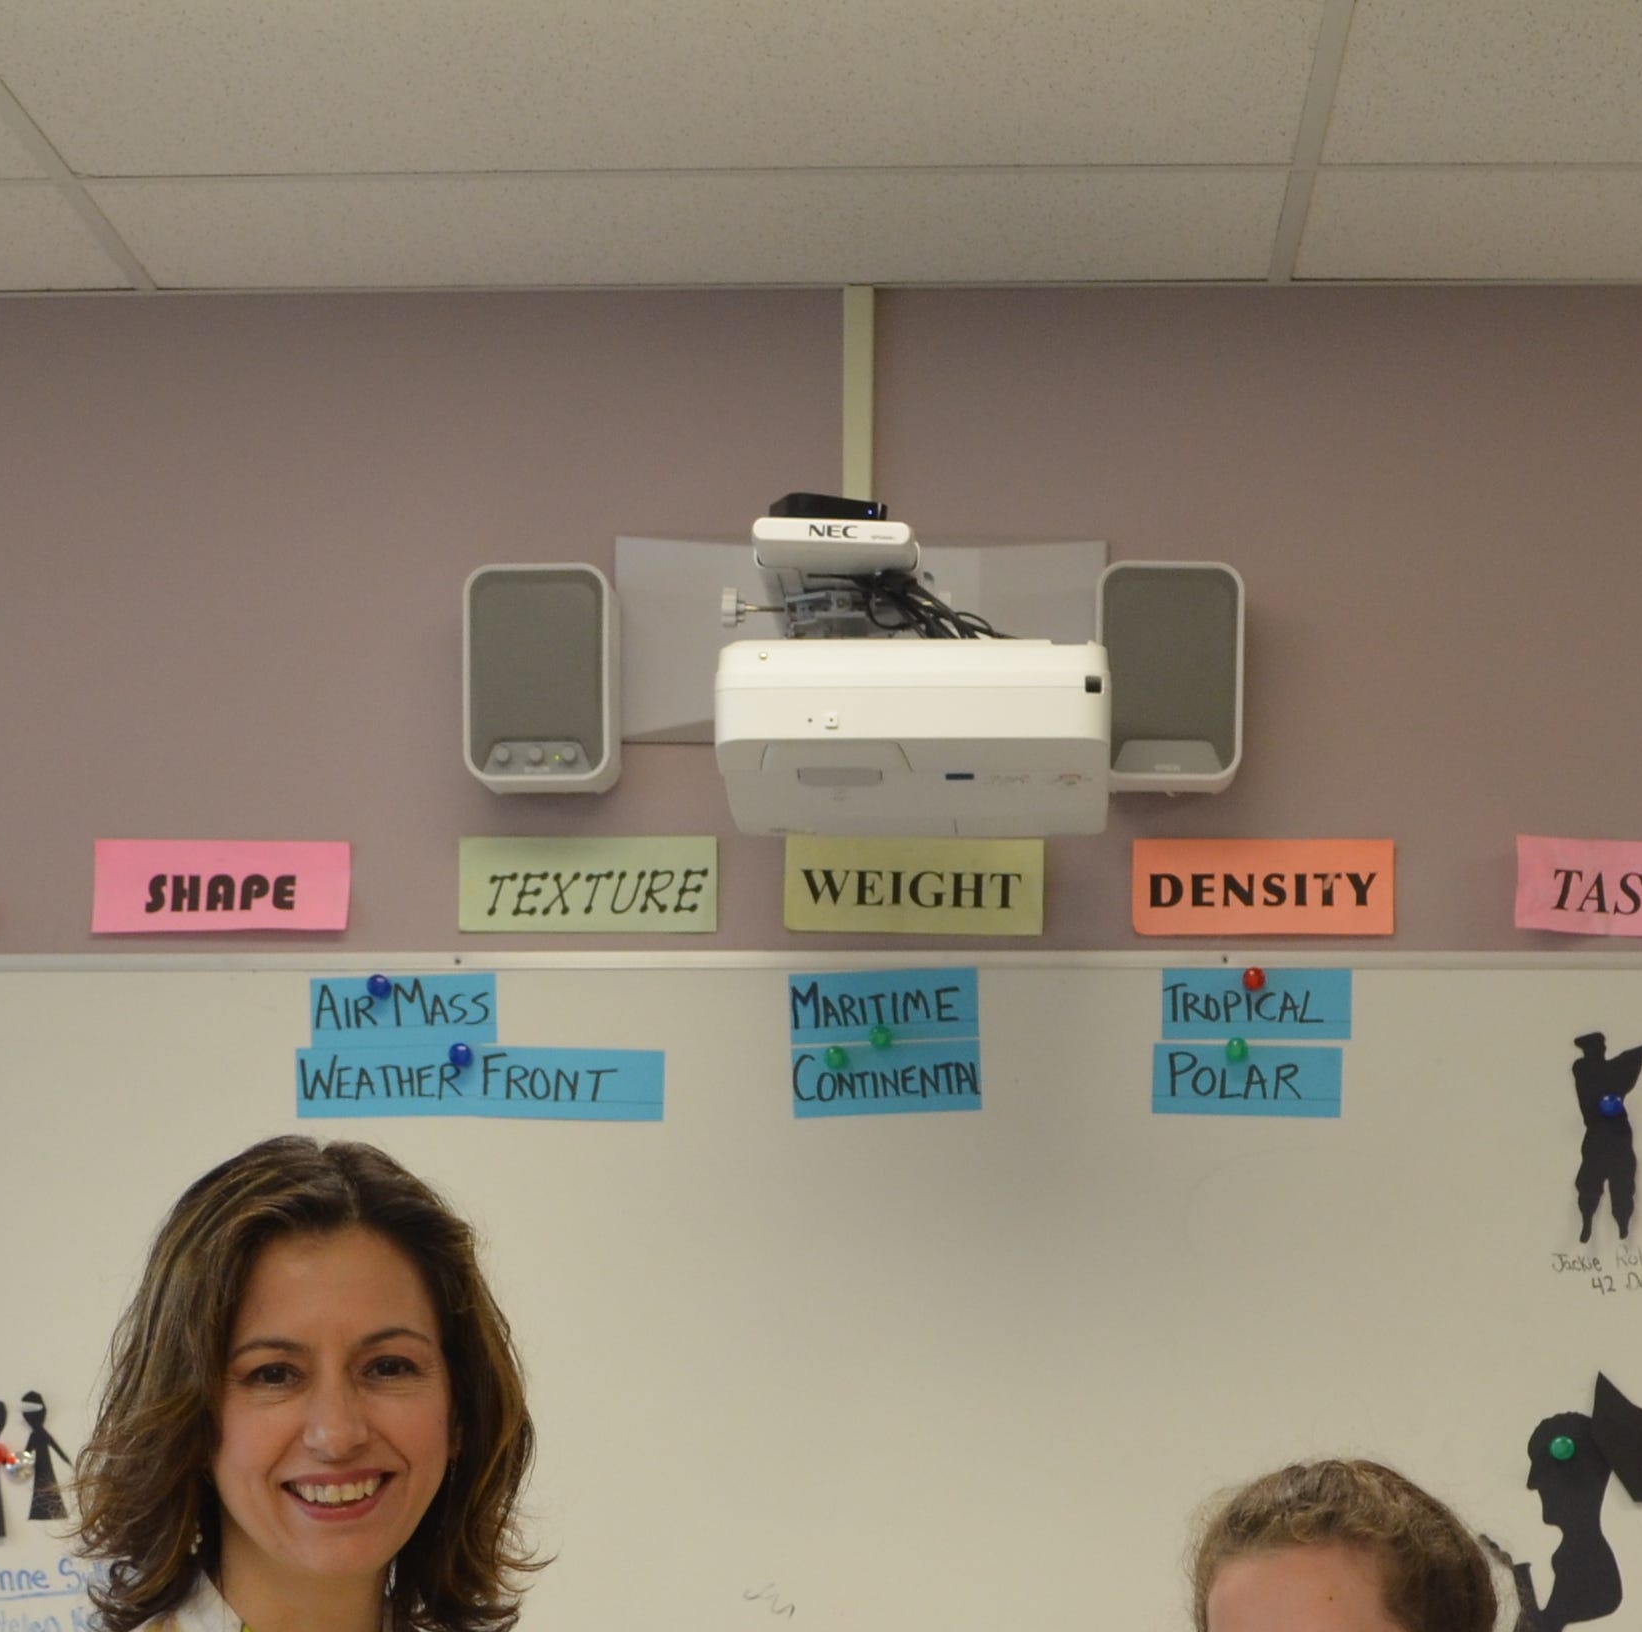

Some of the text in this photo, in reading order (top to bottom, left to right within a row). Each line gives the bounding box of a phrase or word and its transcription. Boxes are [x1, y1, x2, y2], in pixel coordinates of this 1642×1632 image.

[808, 524, 859, 539] NEC
[143, 873, 298, 913] SHAPE
[486, 867, 709, 919] TEXTURE
[800, 869, 1023, 912] WEIGHT
[1149, 871, 1379, 909] DENSITY
[314, 985, 492, 1030] AIR MASS
[790, 980, 961, 1030] MARITIME
[1164, 984, 1325, 1027] TROPICAL
[298, 1052, 620, 1104] WEATHER FRONT
[792, 1054, 981, 1102] CONTINENTAL
[1166, 1056, 1303, 1102] POLAR
